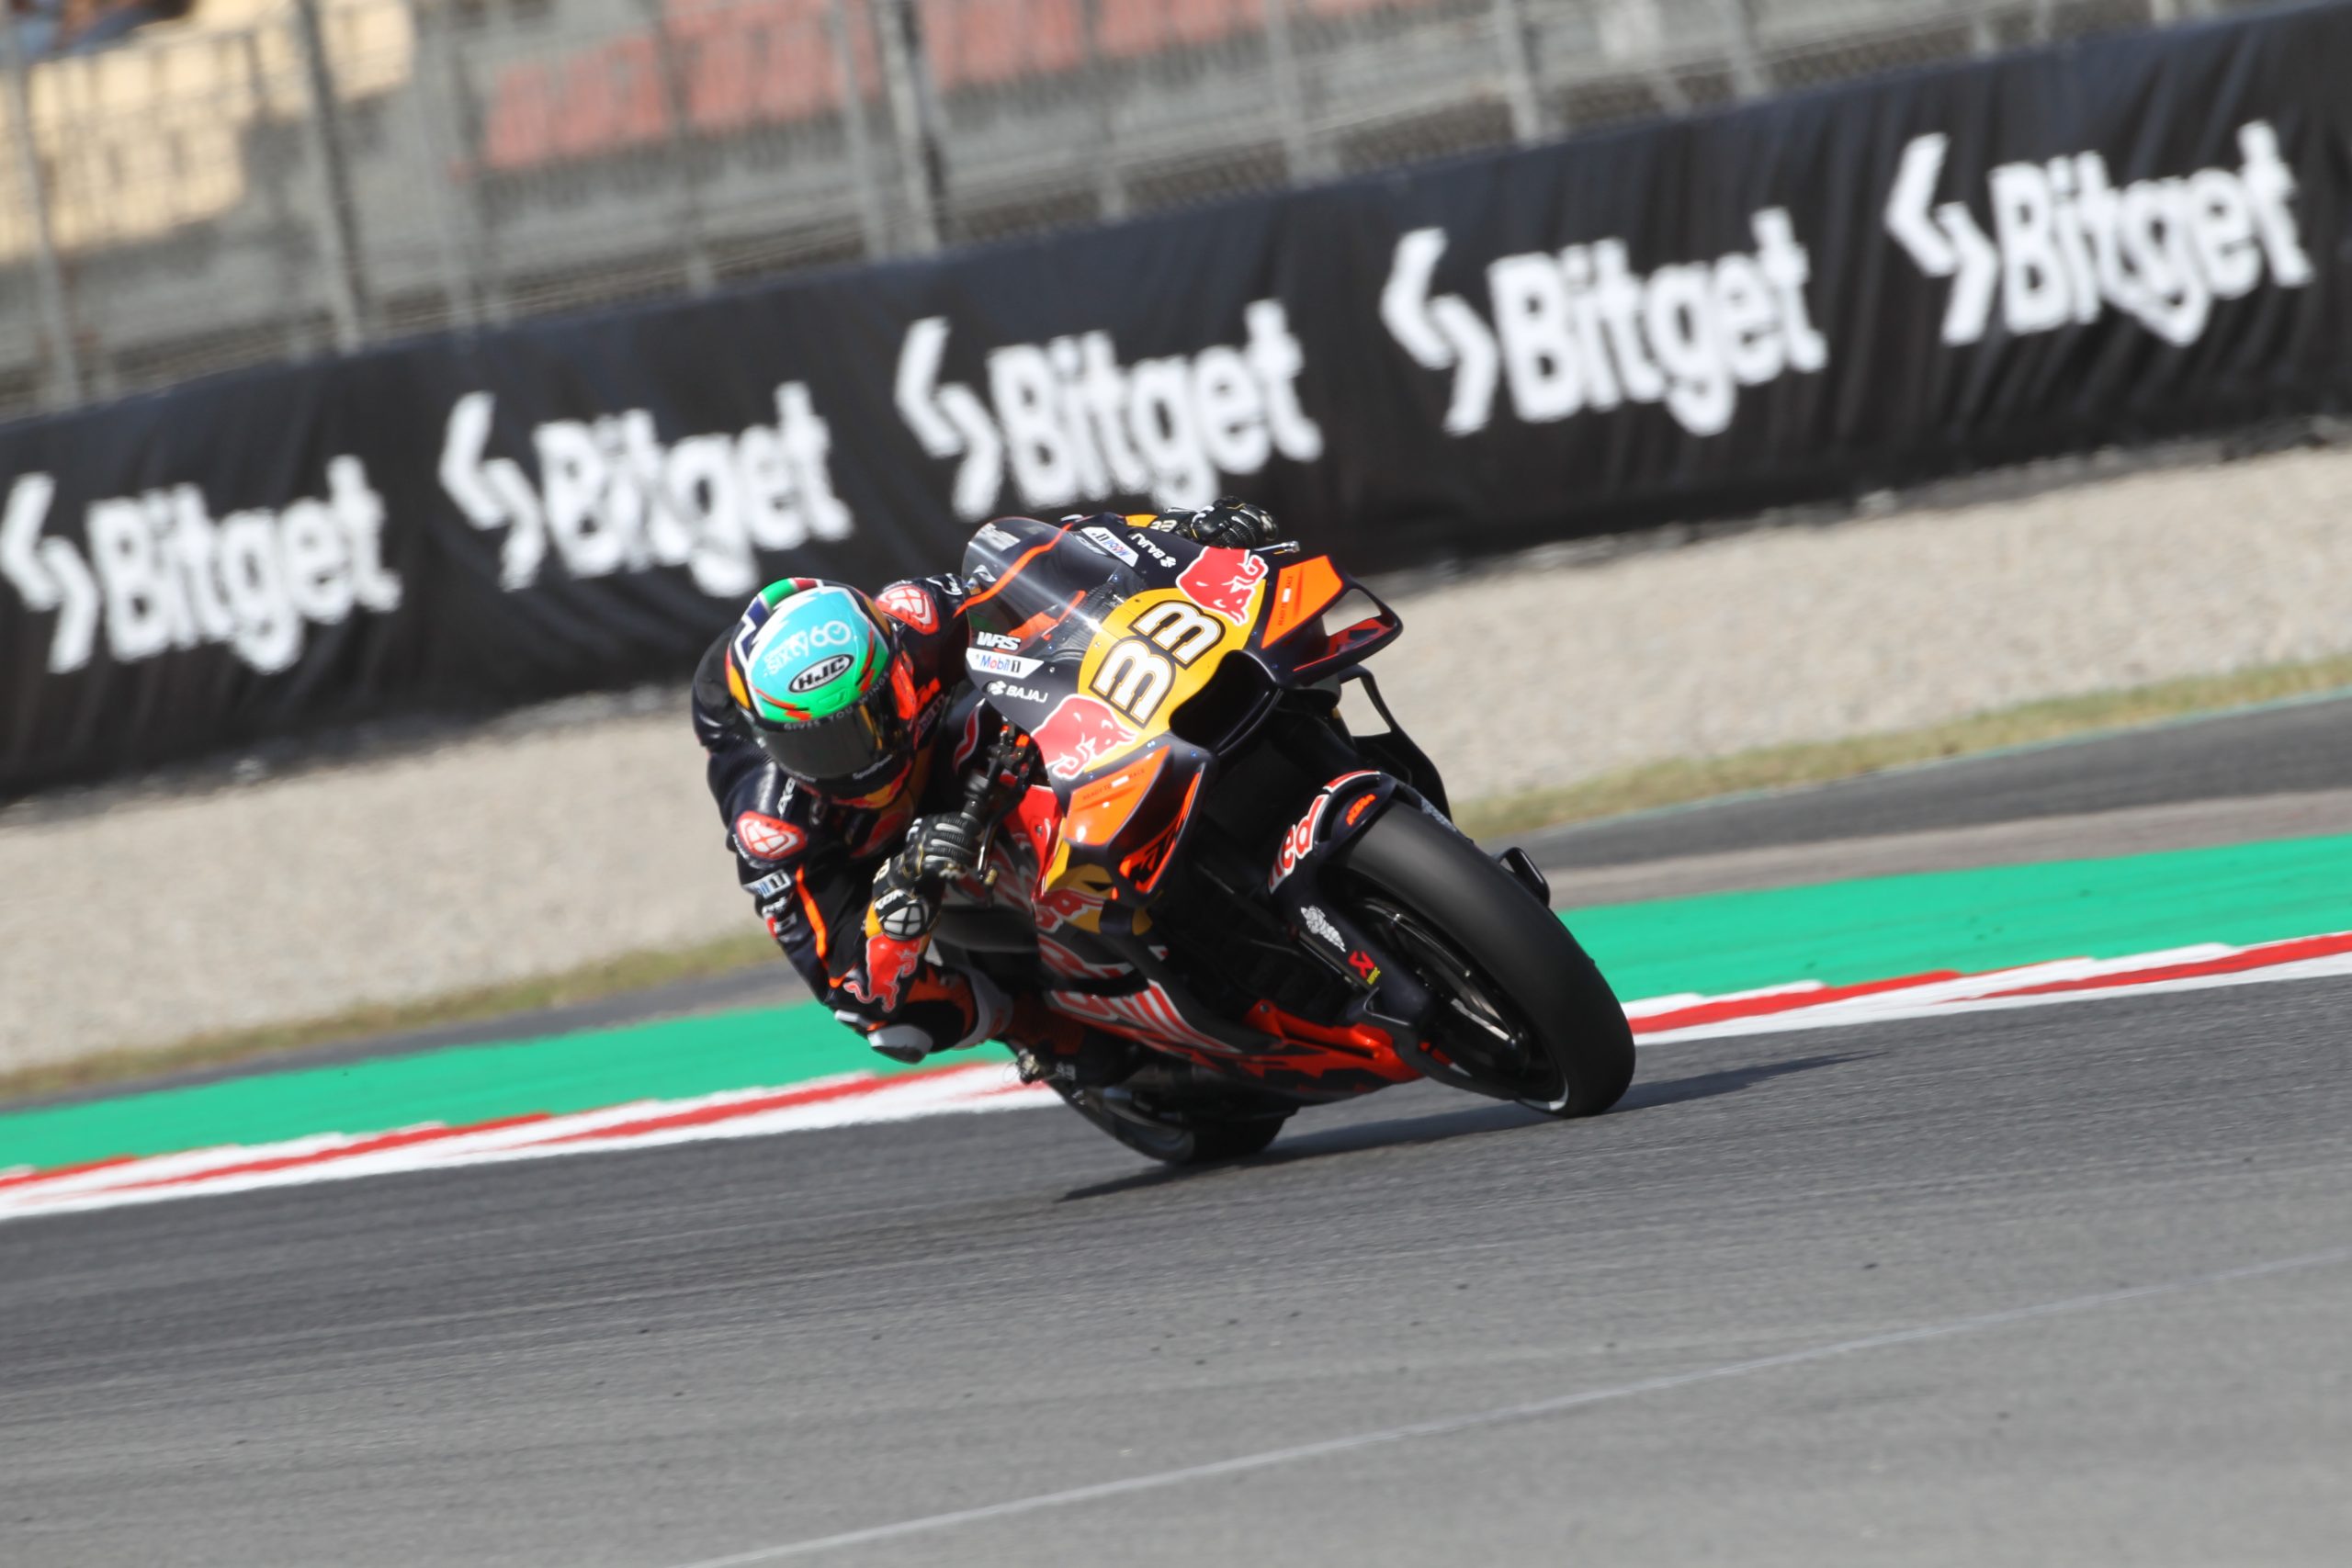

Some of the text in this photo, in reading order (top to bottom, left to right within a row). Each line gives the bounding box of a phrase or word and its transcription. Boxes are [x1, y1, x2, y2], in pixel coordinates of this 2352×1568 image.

[1989, 119, 2314, 346] Bitget
[1487, 206, 1828, 437] Bitget
[987, 298, 1323, 511] Bitget
[532, 380, 854, 597] Bitget
[85, 454, 402, 673] Bitget
[1127, 532, 1166, 559] BAJAJ
[797, 658, 845, 689] HJC
[977, 631, 1022, 651] WRS
[979, 652, 1022, 673] Mobil 1
[1089, 600, 1226, 729] 33
[829, 705, 854, 722] YOU
[1006, 685, 1048, 704] BAJAJ
